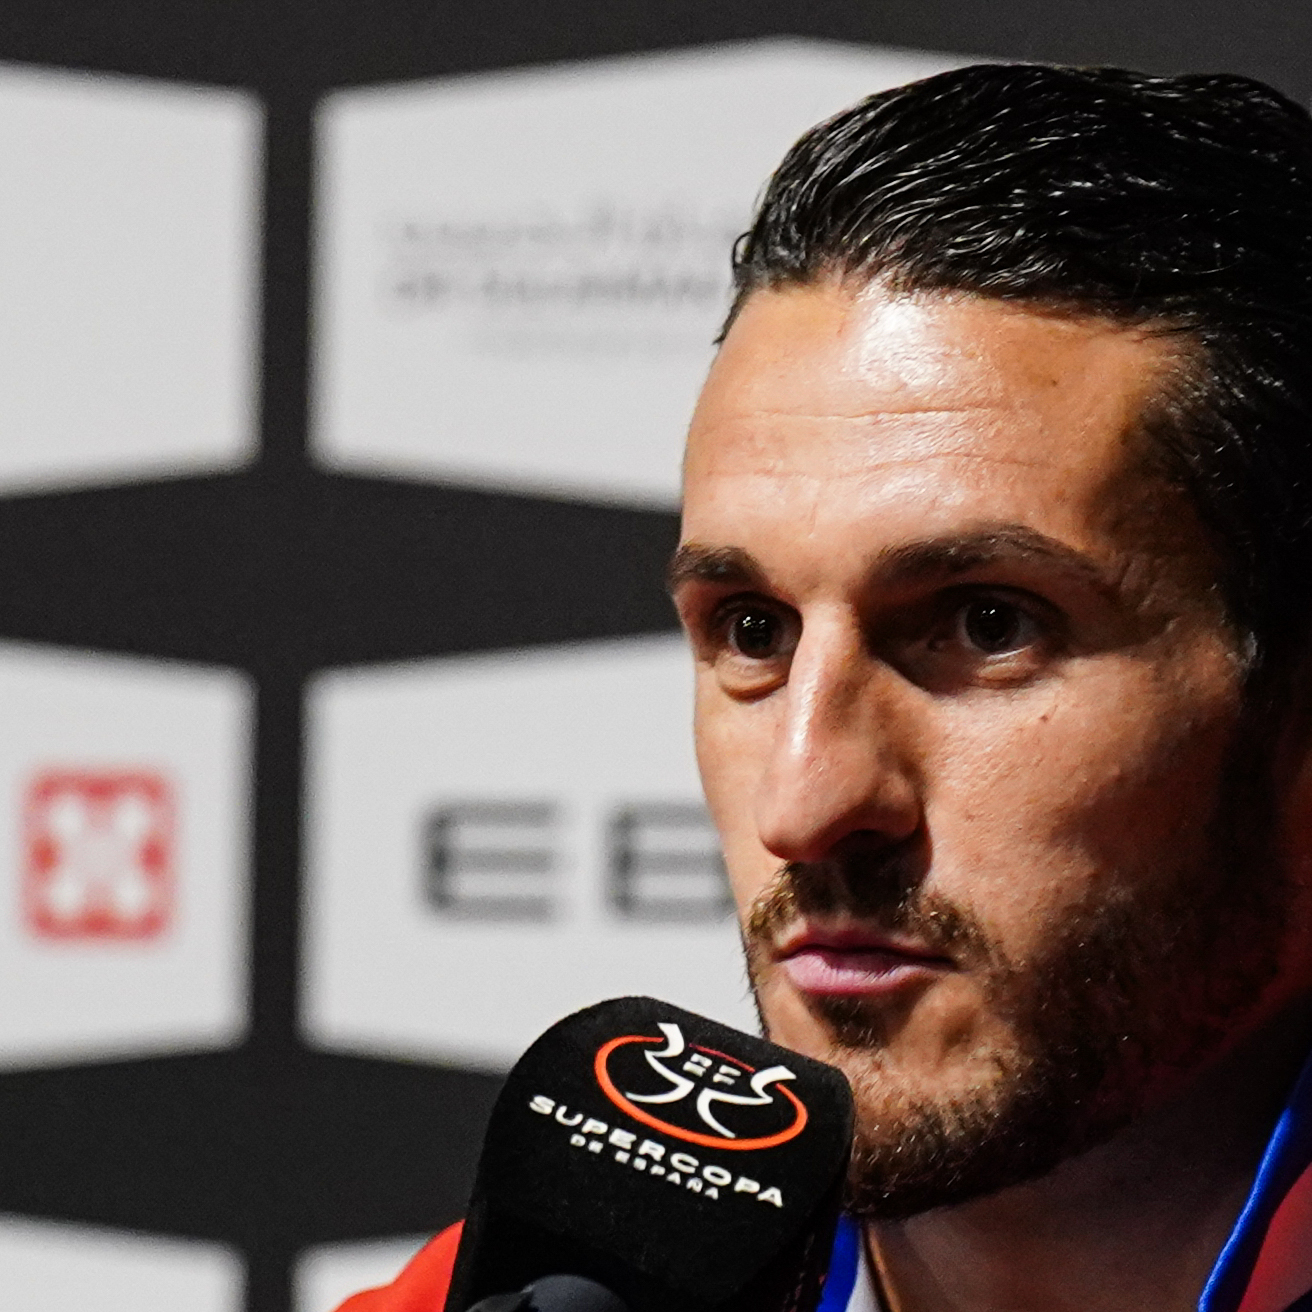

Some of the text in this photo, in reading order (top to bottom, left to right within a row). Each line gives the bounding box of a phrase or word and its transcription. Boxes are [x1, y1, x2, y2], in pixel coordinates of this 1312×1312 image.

[418, 798, 738, 926] EB
[529, 1094, 783, 1208] SUPERCOPA
[570, 1133, 603, 1154] DE
